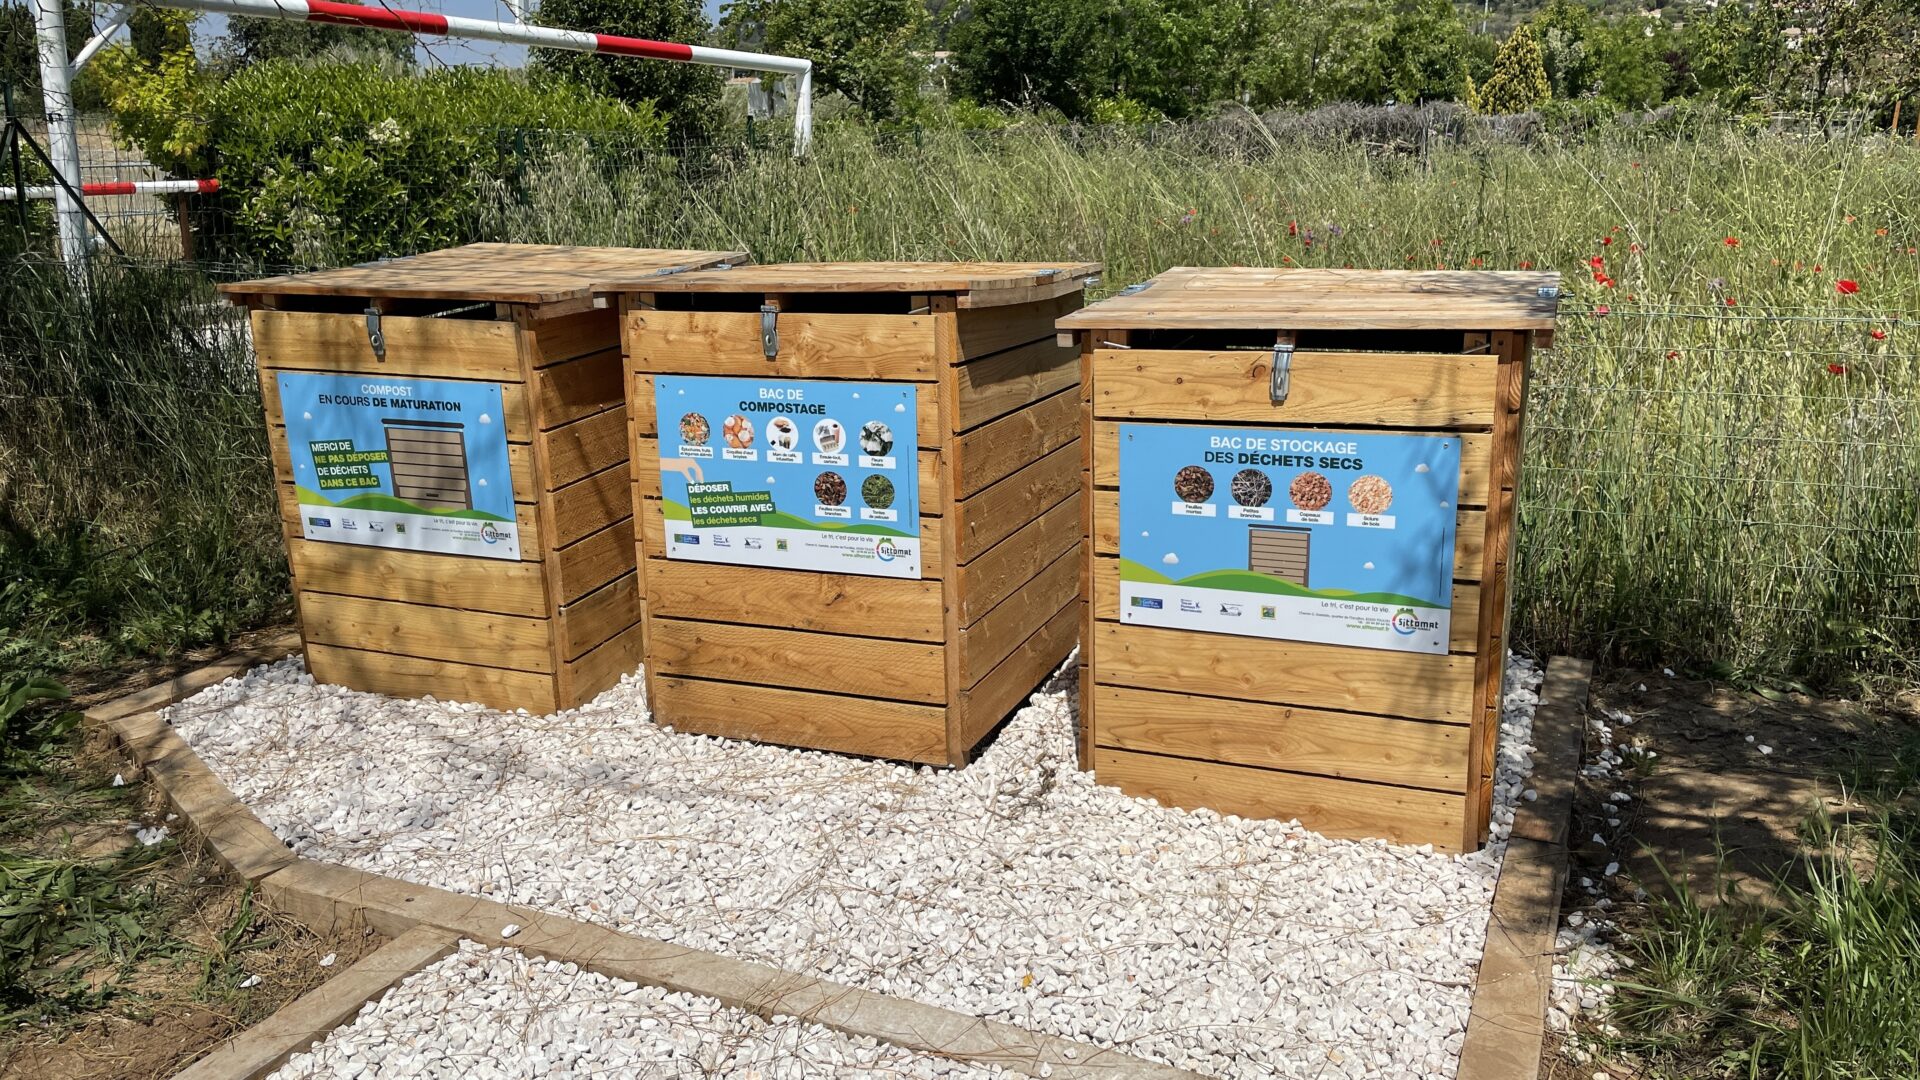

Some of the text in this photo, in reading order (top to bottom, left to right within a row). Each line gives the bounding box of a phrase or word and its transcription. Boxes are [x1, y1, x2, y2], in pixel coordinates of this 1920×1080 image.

[361, 384, 413, 396] COMPOST
[759, 387, 804, 401] BAC DE
[319, 394, 462, 412] EN COURS DE MATURATION
[739, 401, 827, 415] COMPOSTAGE
[311, 441, 352, 452] MERCI DE
[1210, 436, 1358, 455] BAC DE STOCKAGE
[314, 451, 388, 464] NE PAS DÉPOSER
[1204, 450, 1364, 471] DES DÉCHETS SECS
[317, 463, 369, 476] DE DÉCHETS
[321, 477, 378, 488] DANS CE BAC
[688, 483, 729, 493] DÉPOSER
[690, 493, 770, 504] les déchets humides
[691, 503, 773, 515] LES COUVRIR AVEC
[693, 517, 705, 525] les
[706, 516, 737, 525] déchets
[1355, 604, 1371, 612] pour
